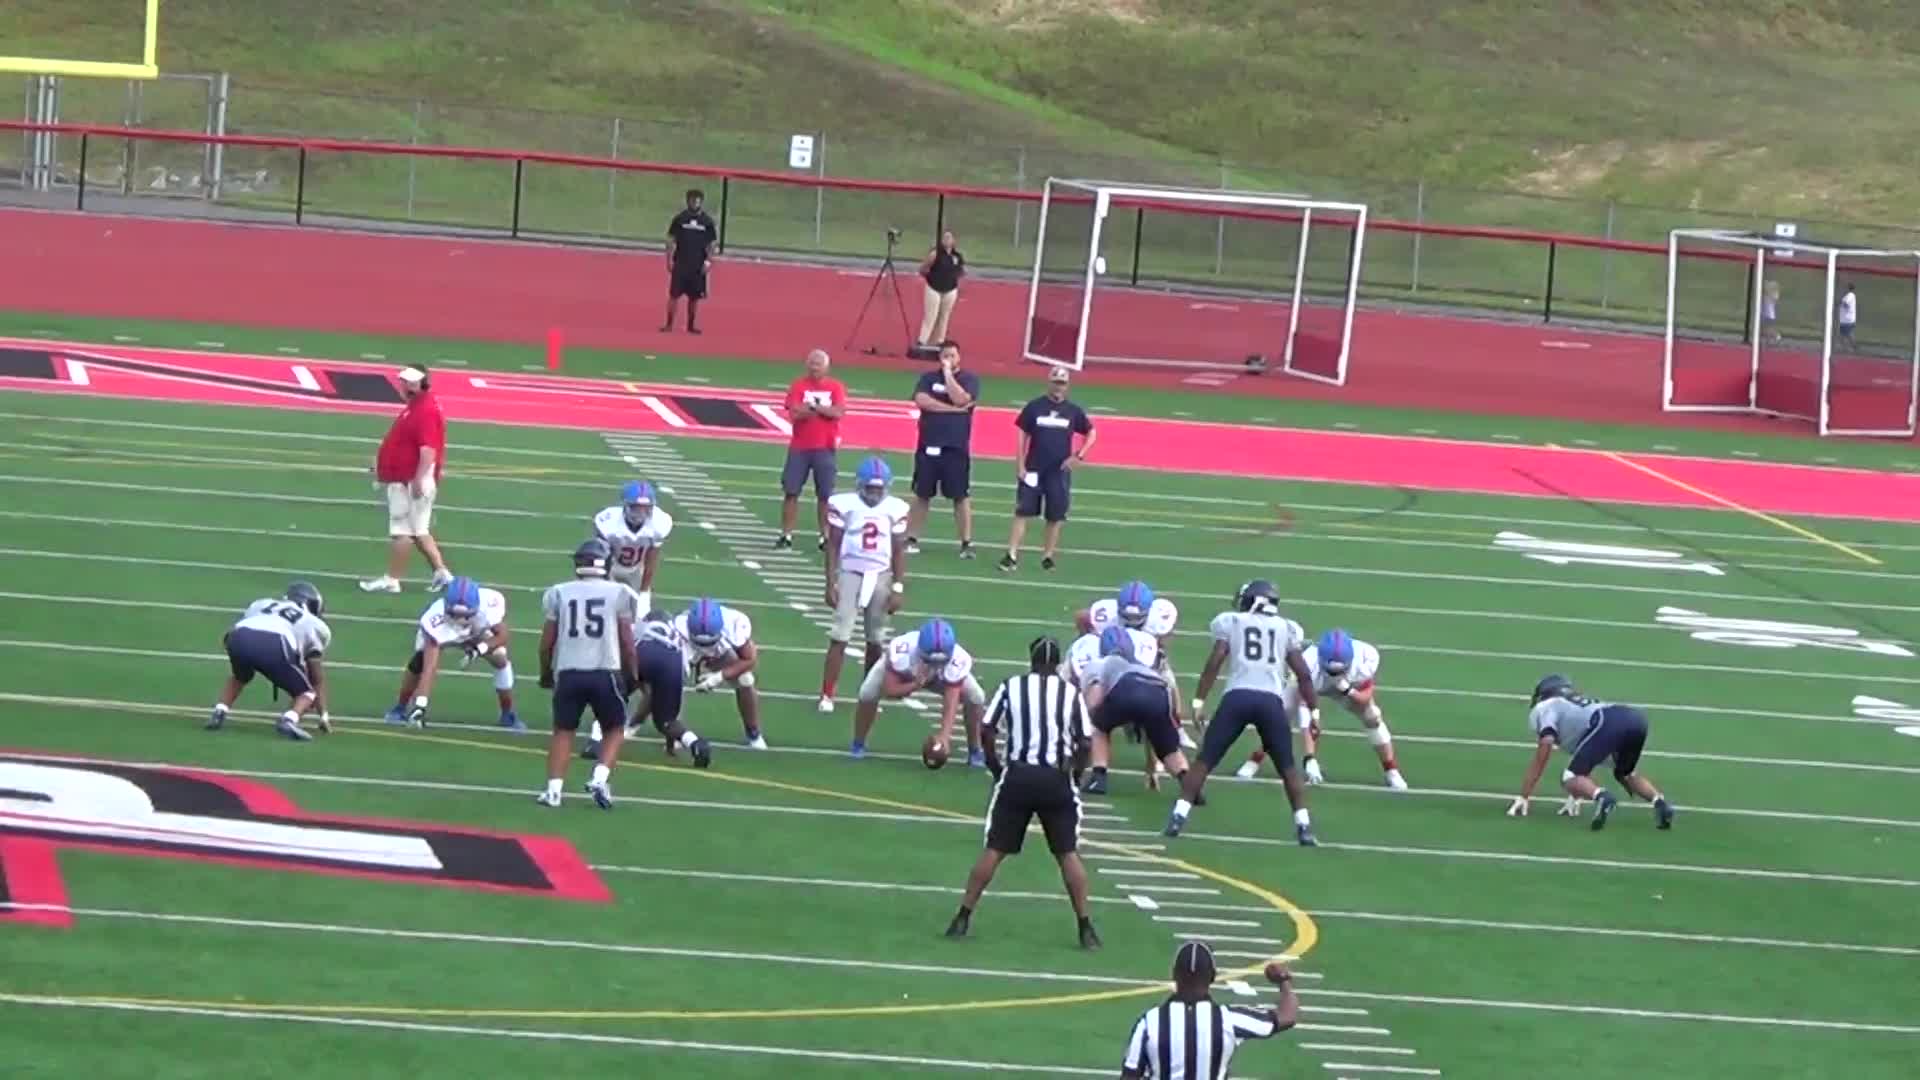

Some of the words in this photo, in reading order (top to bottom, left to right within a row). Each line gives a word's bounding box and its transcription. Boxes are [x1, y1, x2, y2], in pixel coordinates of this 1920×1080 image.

[862, 522, 878, 550] 2
[618, 546, 645, 567] 21
[568, 598, 606, 638] 15
[1244, 626, 1276, 663] 61
